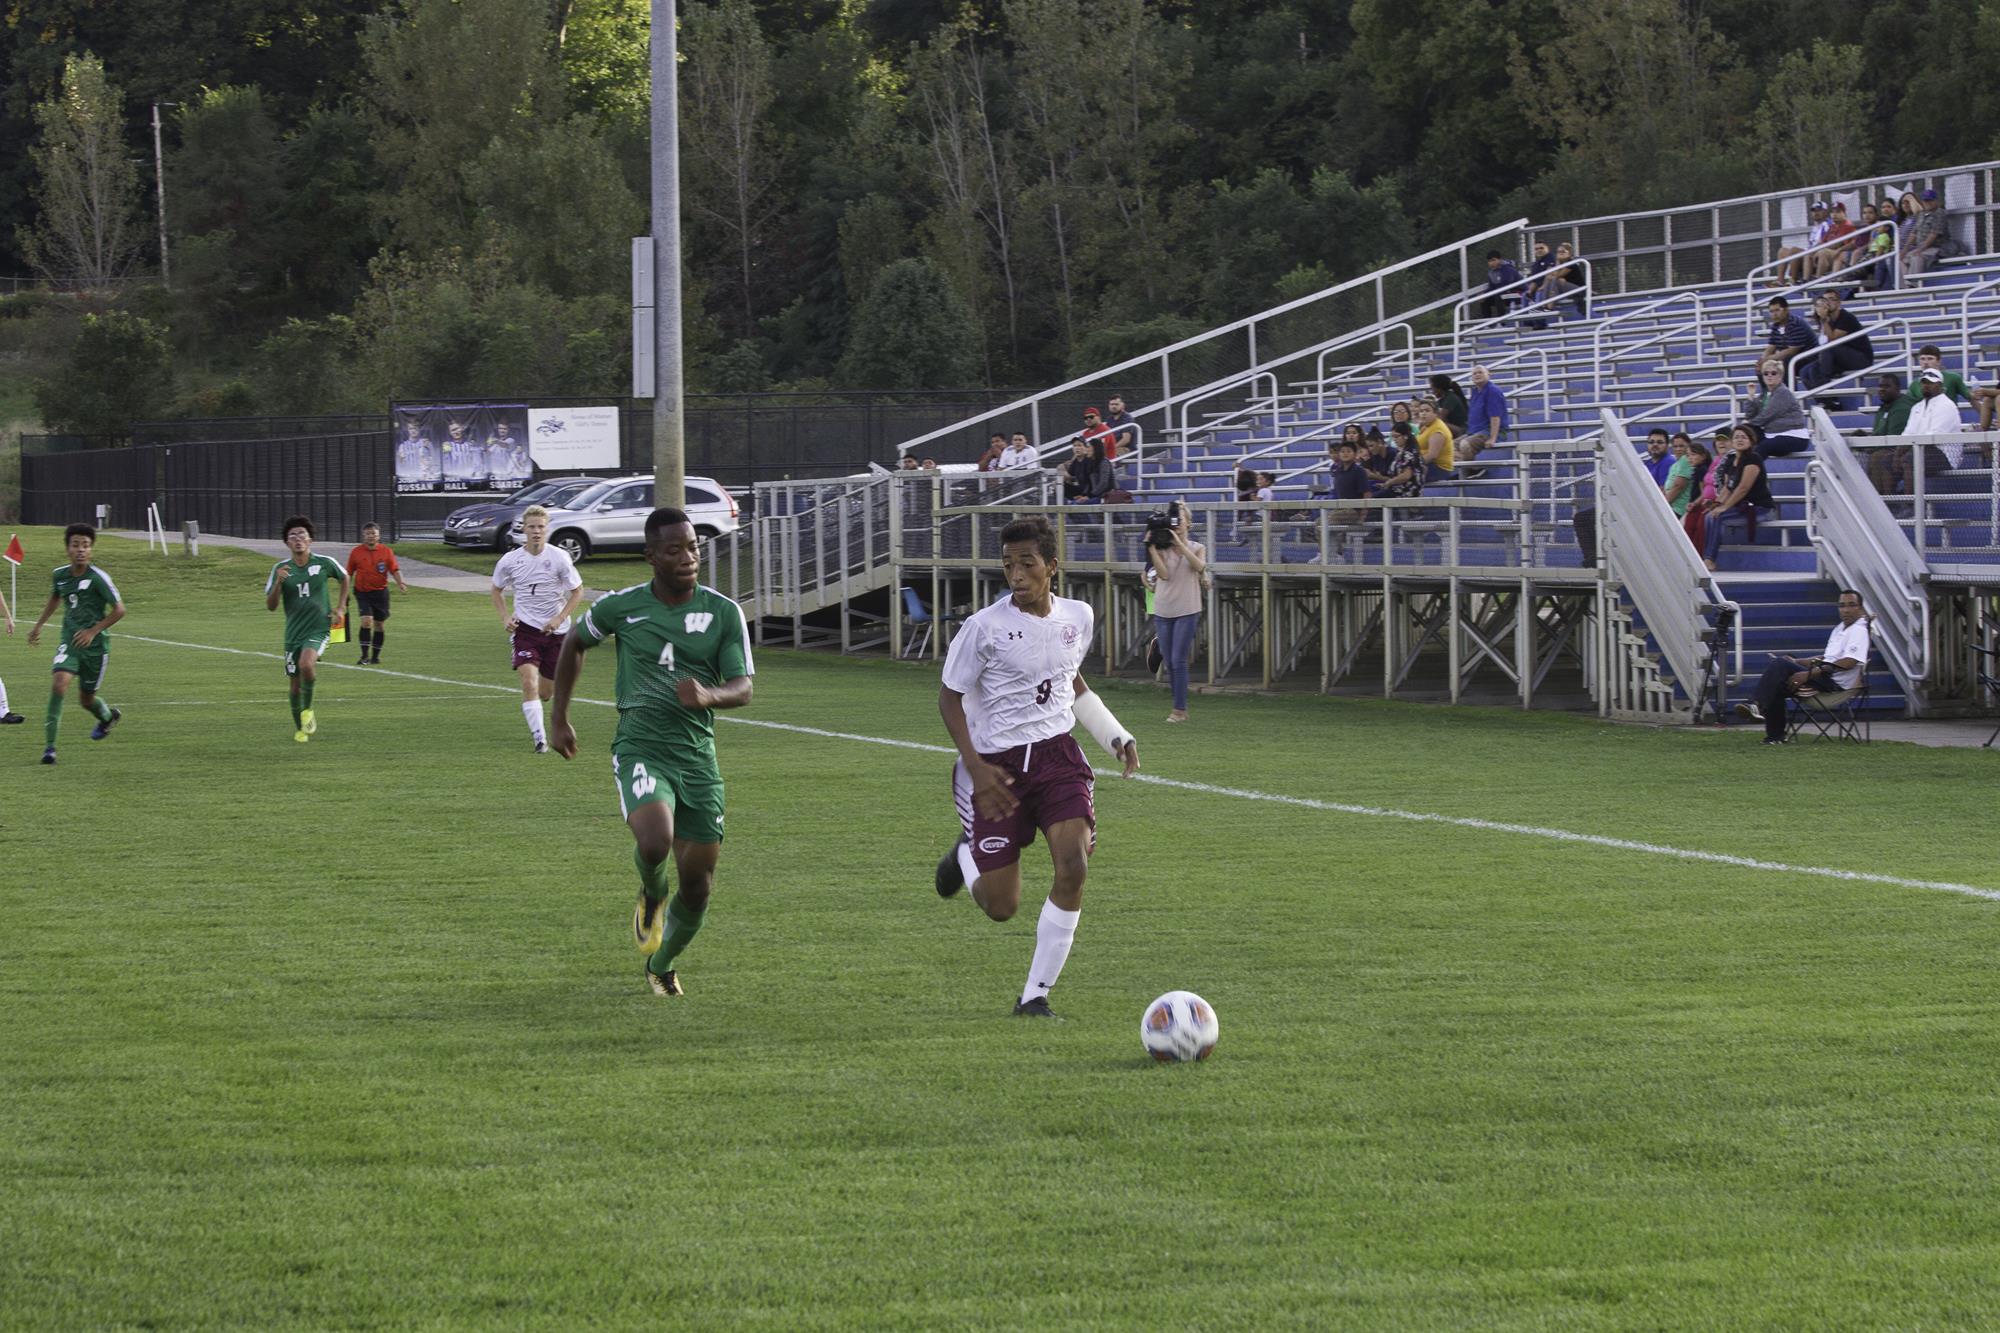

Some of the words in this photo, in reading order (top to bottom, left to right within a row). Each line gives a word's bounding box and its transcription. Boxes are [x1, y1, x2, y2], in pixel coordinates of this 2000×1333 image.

[444, 482, 469, 491] HALL
[489, 480, 524, 489] SUAREZ
[296, 582, 310, 598] 14
[529, 583, 537, 596] 7
[68, 593, 79, 609] 9
[684, 612, 714, 634] W
[658, 642, 675, 672] 4
[1036, 679, 1052, 705] 9
